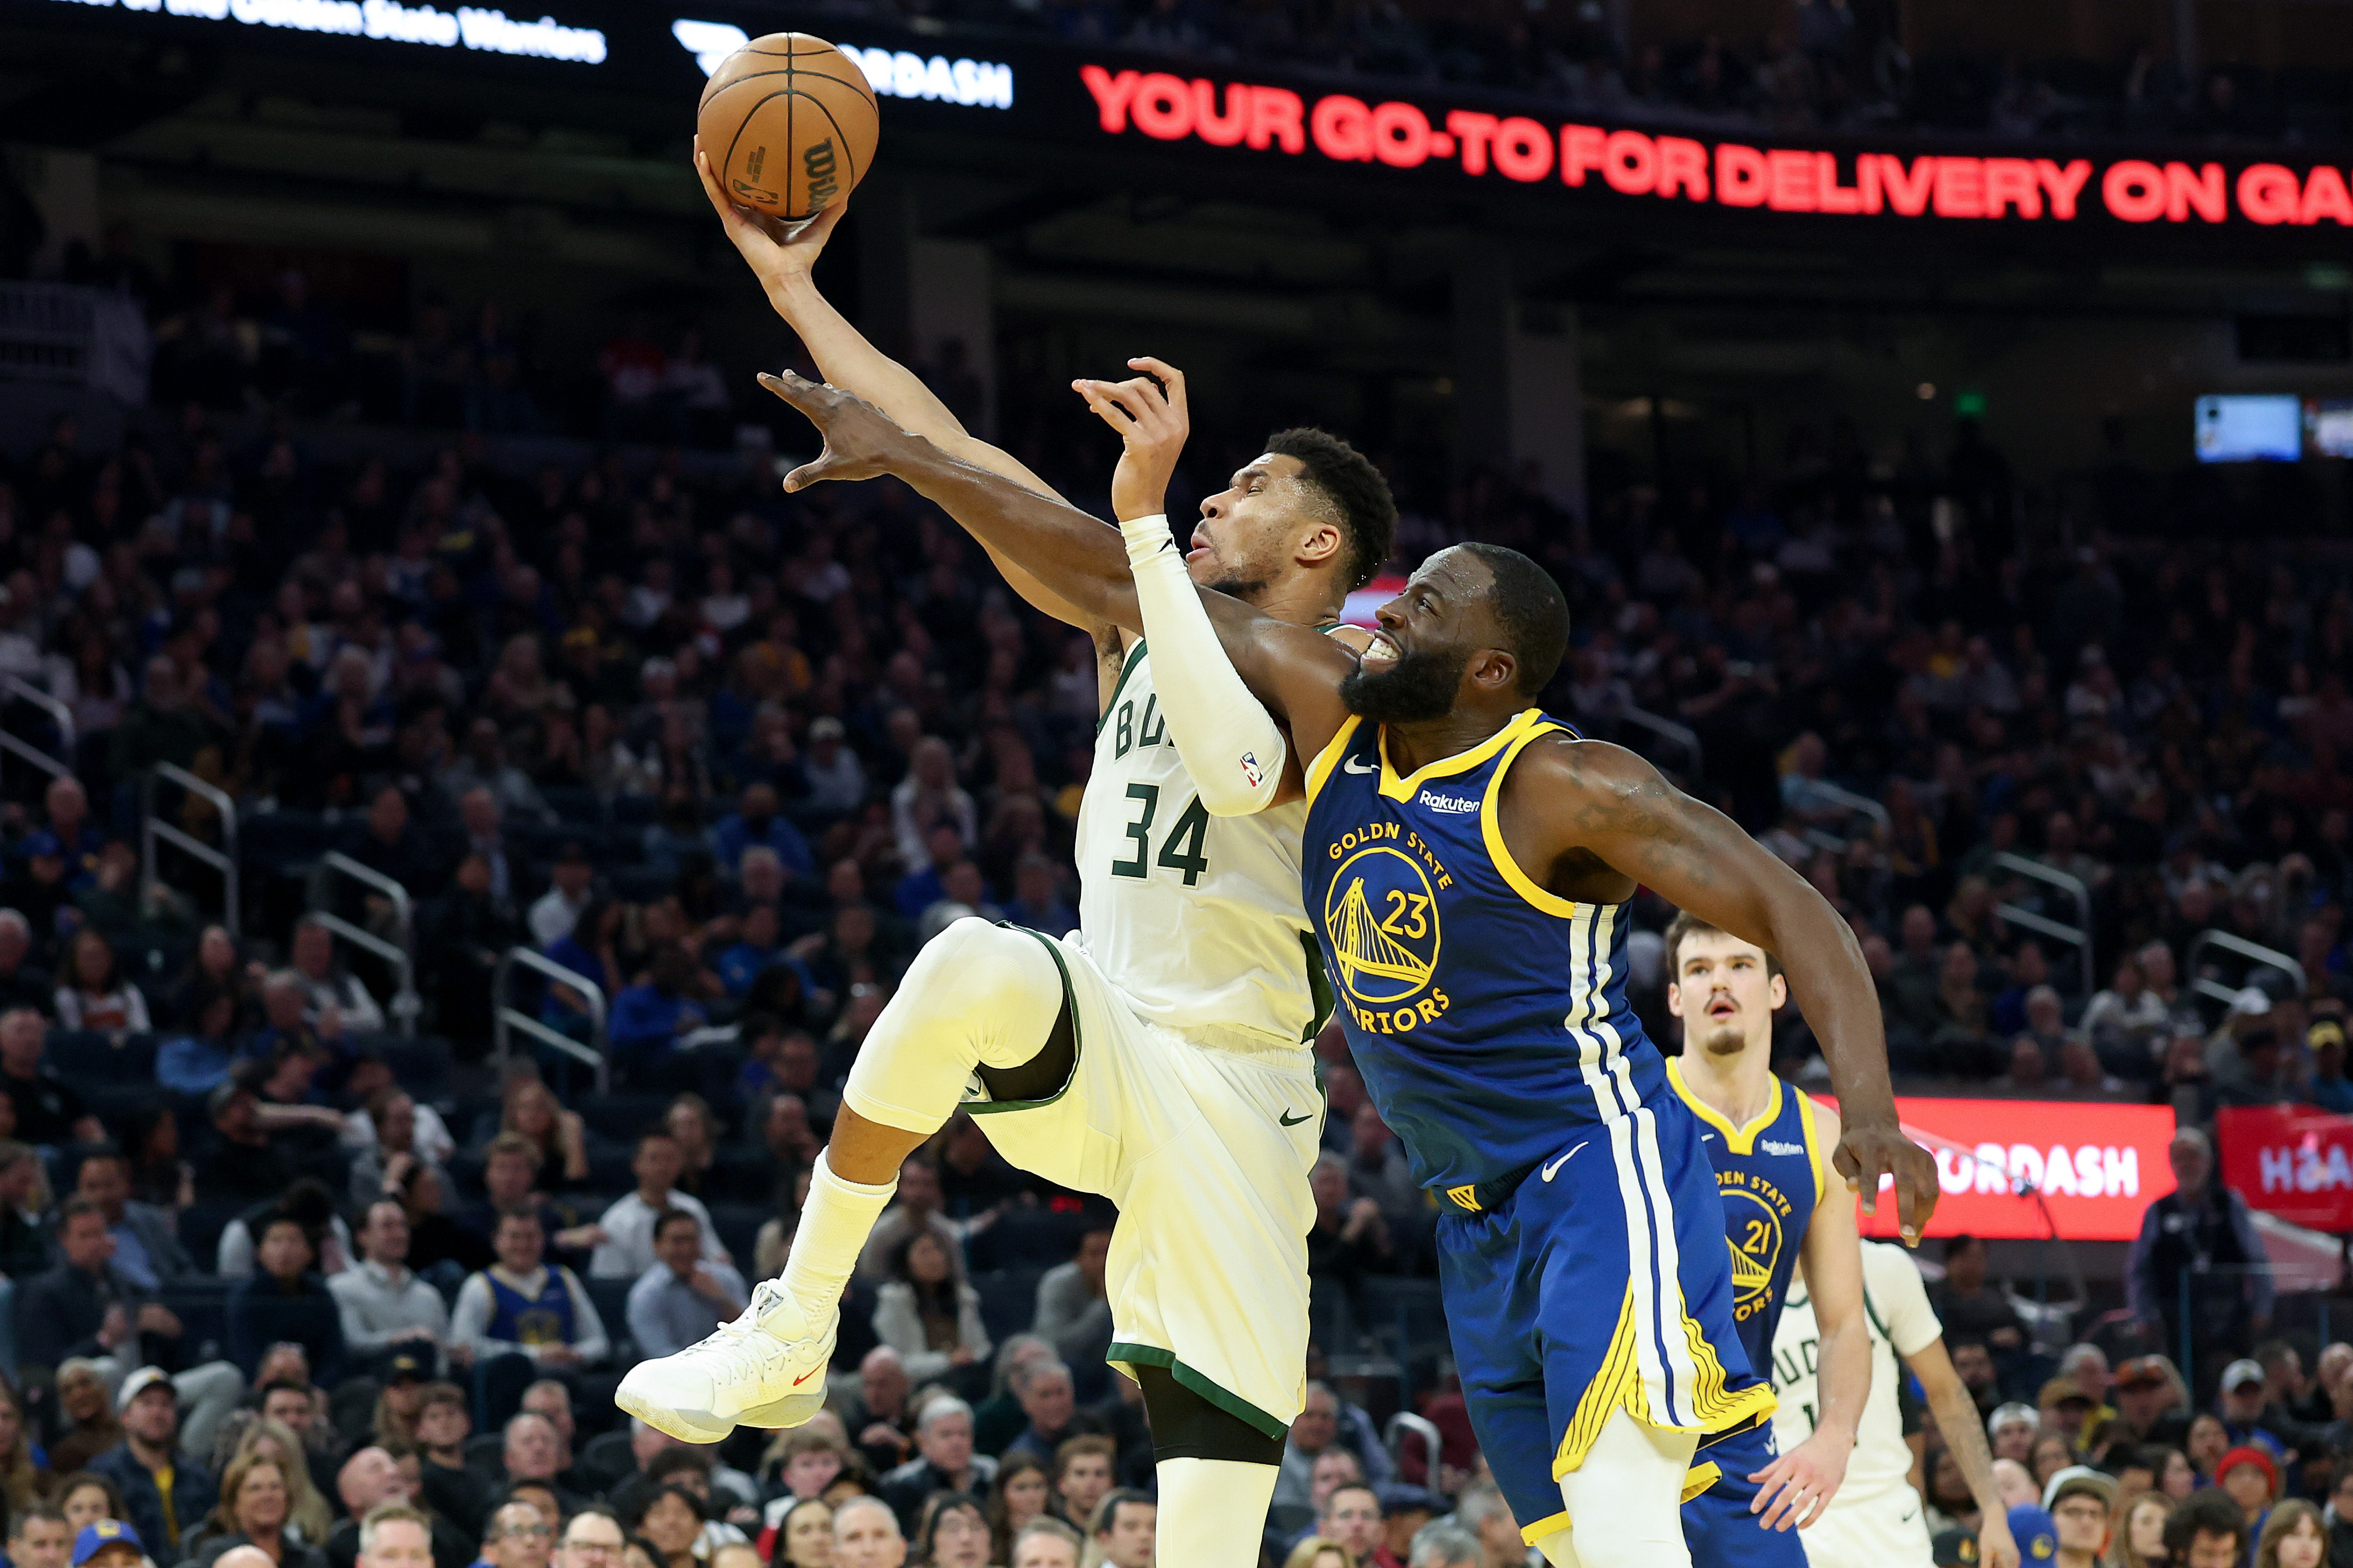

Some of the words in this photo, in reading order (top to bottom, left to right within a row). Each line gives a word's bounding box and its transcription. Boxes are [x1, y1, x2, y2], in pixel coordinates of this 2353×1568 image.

[837, 43, 1013, 109] RDASH
[1080, 65, 1305, 154] YOUR
[1310, 94, 1554, 182] GO-TO
[1560, 123, 1710, 202] FOR
[1715, 143, 2093, 221] DELIVERY
[2102, 160, 2227, 223] ON
[2237, 163, 2353, 226] GA
[1115, 693, 1175, 760] BU
[1419, 790, 1480, 813] Rakuten
[1111, 783, 1209, 887] 34
[1329, 822, 1400, 859] GOLDN
[1407, 831, 1453, 890] STATE
[1382, 890, 1429, 939] 23
[1327, 954, 1450, 1035] ARRIORS
[1761, 1139, 1804, 1156] Rakuten
[1878, 1141, 2139, 1197] ORDASH
[1715, 1170, 1746, 1185] DEN
[1750, 1176, 1793, 1217] STATE
[1743, 1220, 1771, 1254] 21
